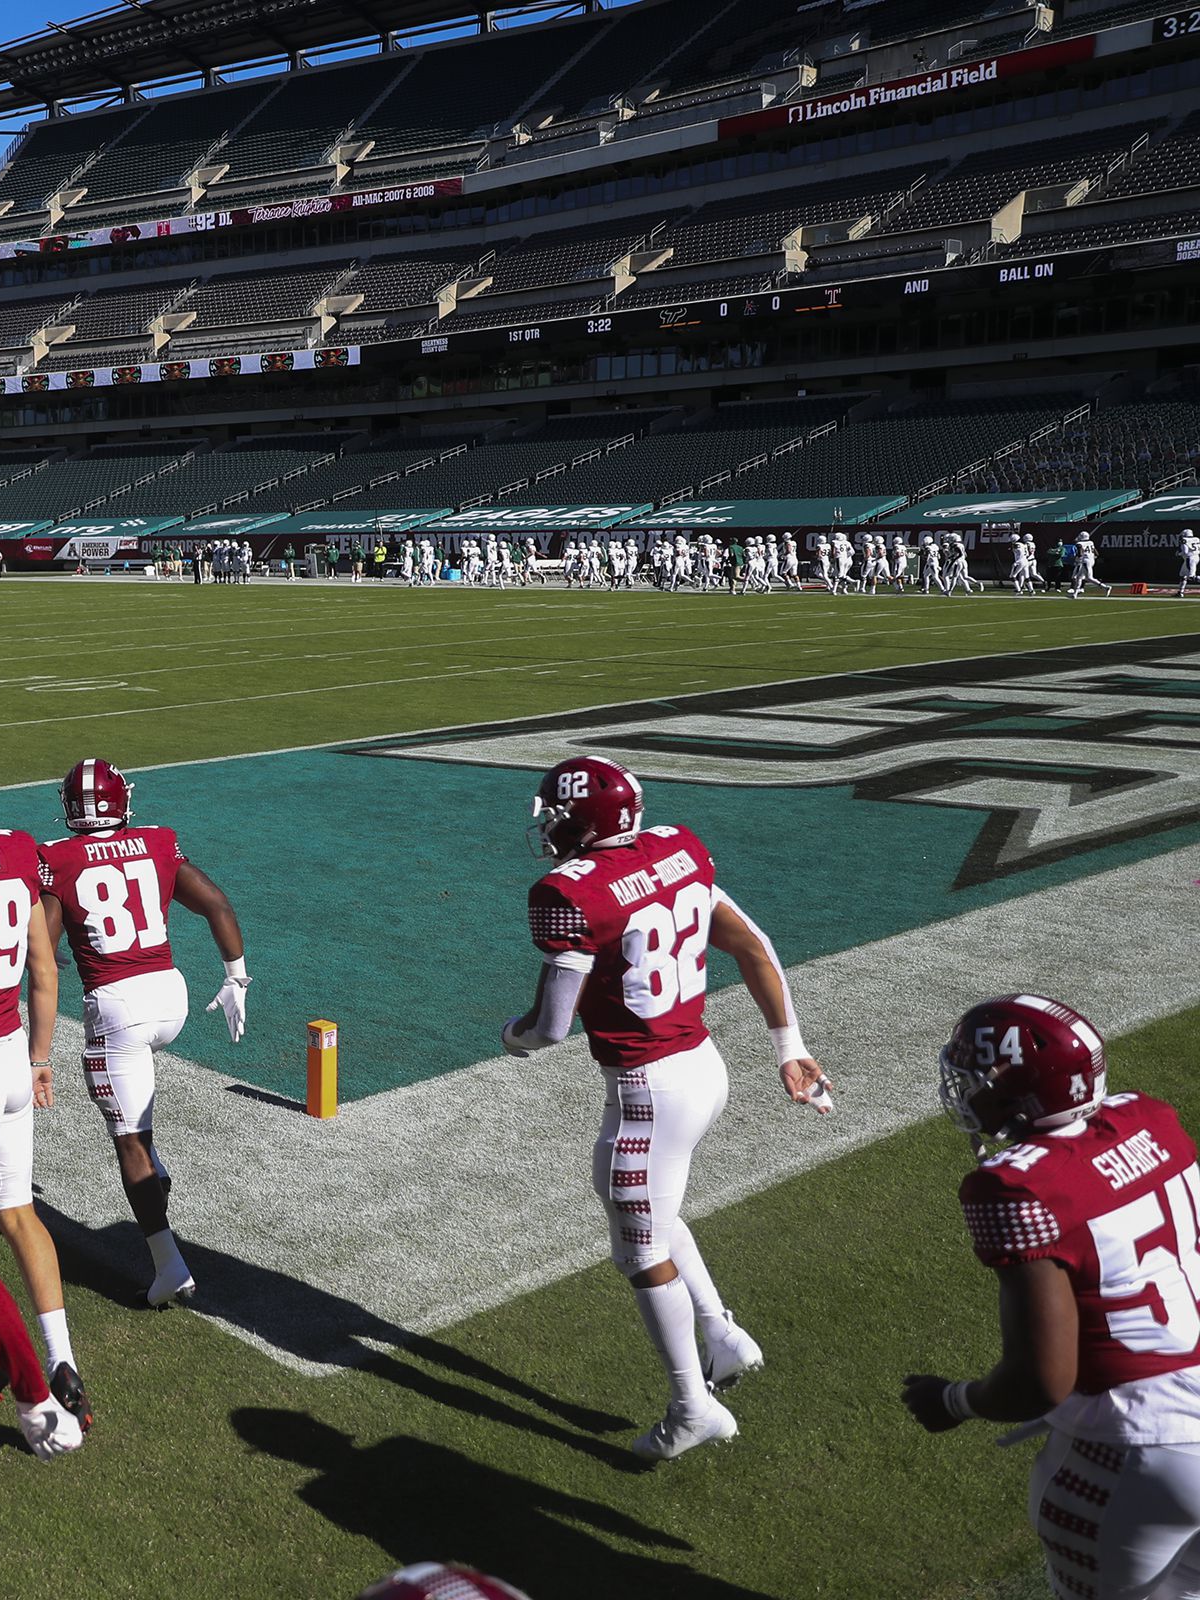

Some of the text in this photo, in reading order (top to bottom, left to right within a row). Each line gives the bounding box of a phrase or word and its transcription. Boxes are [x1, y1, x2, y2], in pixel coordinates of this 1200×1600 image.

[806, 61, 998, 121] Lincoln Financial Field
[384, 189, 404, 202] 2007
[413, 185, 435, 198] 2008
[218, 212, 232, 226] DL
[1000, 263, 1054, 282] BALL ON
[904, 279, 929, 294] AND
[509, 328, 540, 342] 1ST QTR
[587, 318, 612, 333] 3:22
[1100, 531, 1180, 548] AMERICAN
[557, 770, 589, 800] 82
[73, 819, 111, 827] TEMPLE
[84, 837, 148, 862] PITTMAN
[75, 858, 168, 955] 81
[621, 880, 713, 1019] 82
[974, 1026, 1024, 1066] 54
[1091, 1128, 1171, 1191] SHARPE
